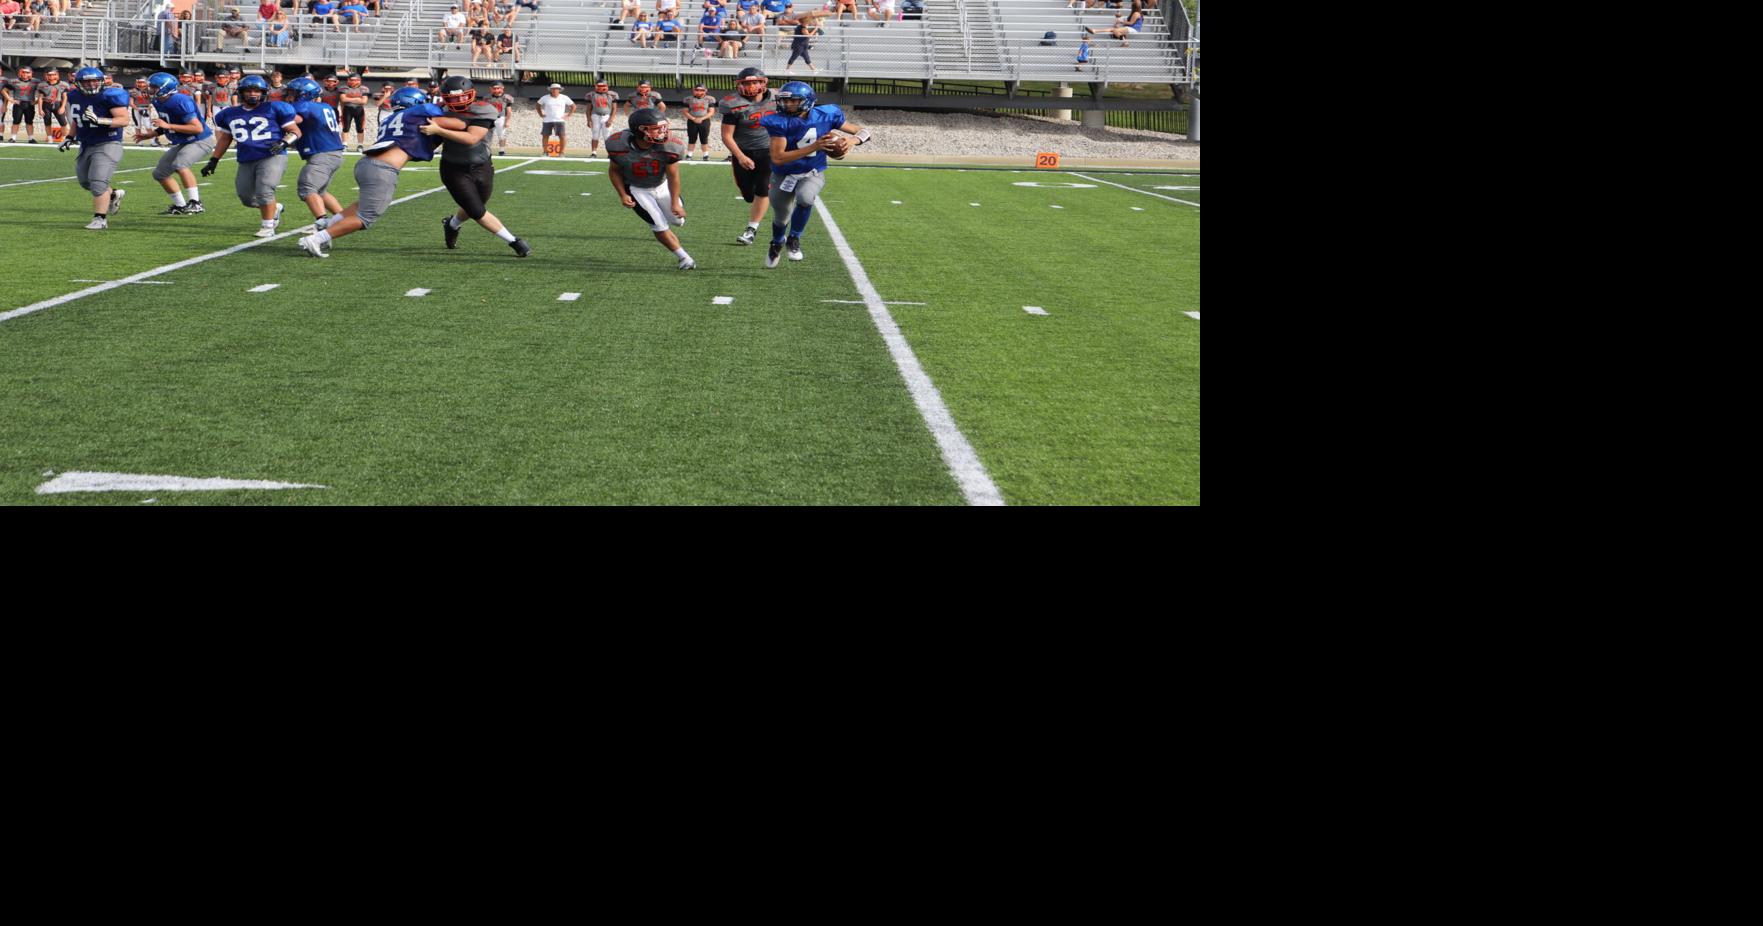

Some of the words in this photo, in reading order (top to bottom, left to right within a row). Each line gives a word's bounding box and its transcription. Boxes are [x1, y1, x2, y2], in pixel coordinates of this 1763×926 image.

[229, 116, 272, 142] 62
[797, 127, 818, 157] 4
[1039, 155, 1057, 166] 20
